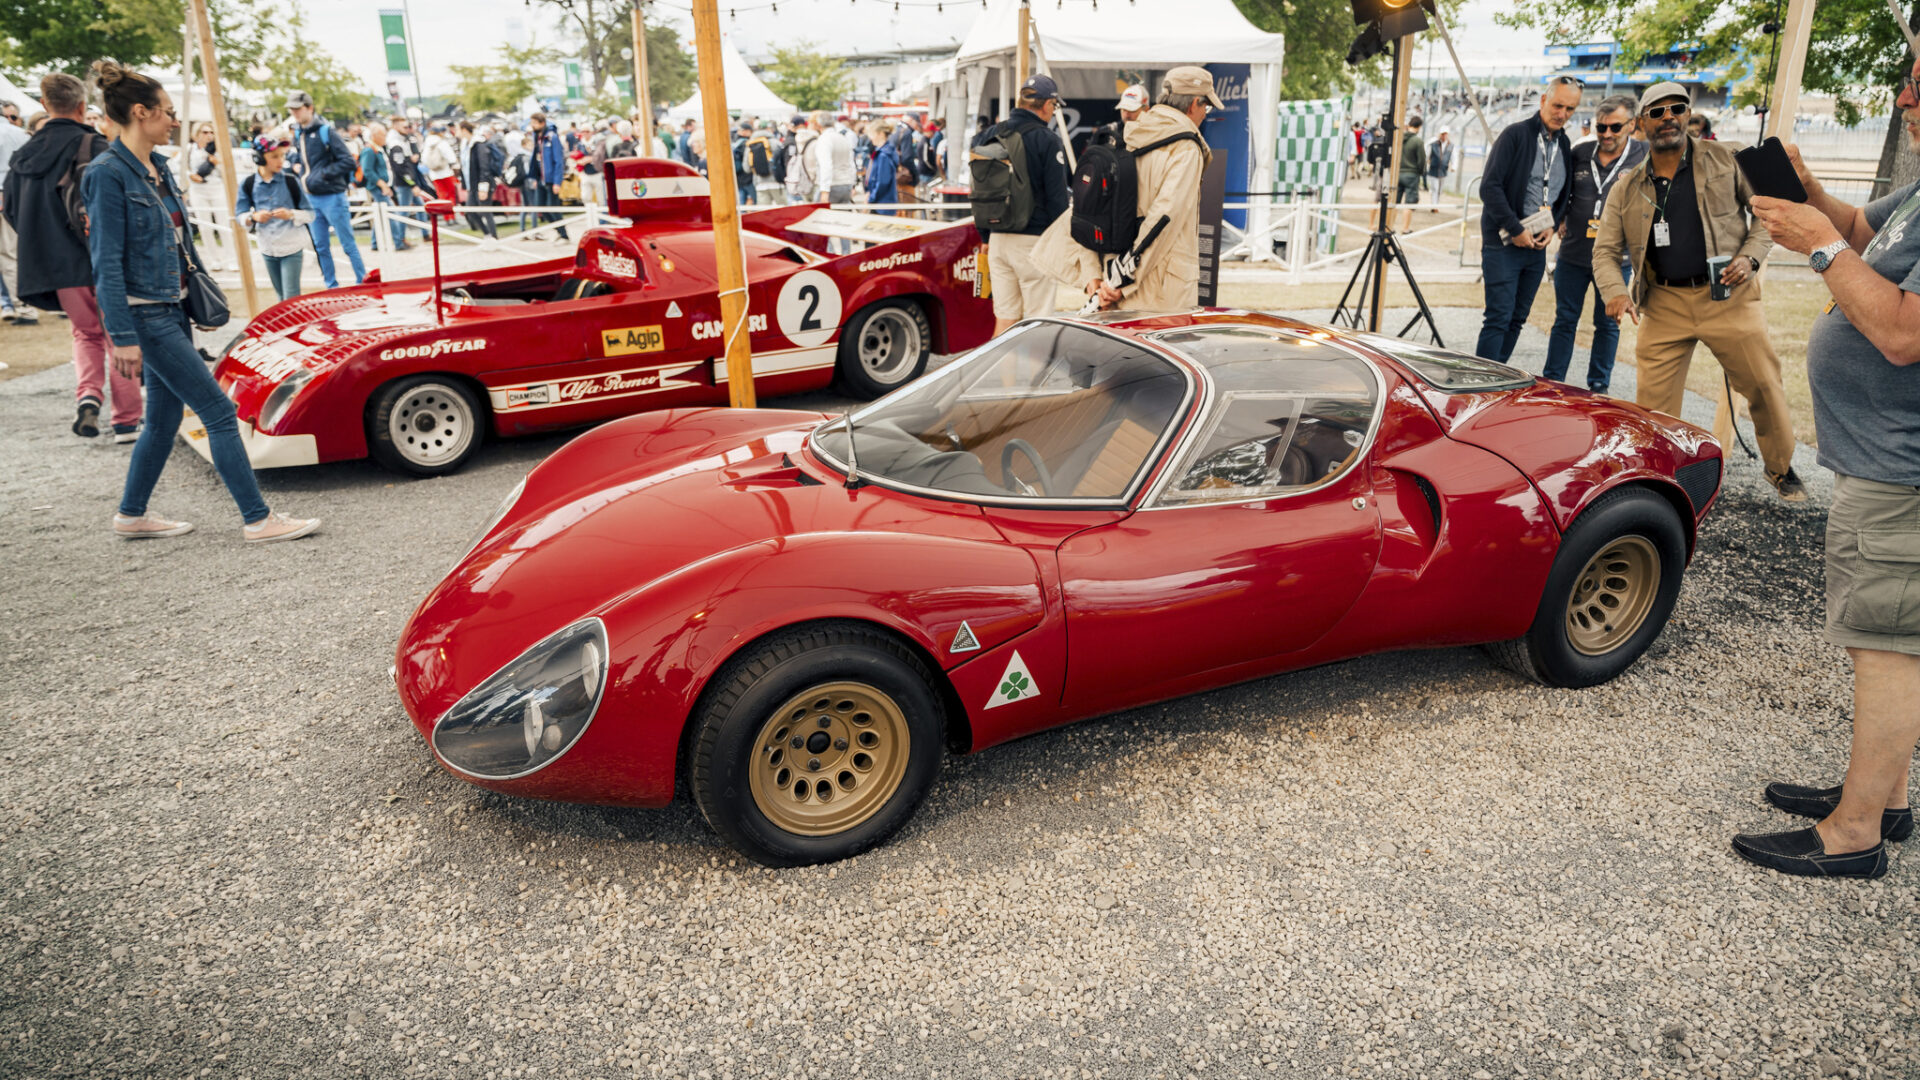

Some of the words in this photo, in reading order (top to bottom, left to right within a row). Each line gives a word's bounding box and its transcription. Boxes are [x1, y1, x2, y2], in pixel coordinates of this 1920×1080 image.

[859, 252, 923, 272] GOODYEAR
[798, 285, 821, 331] 2
[691, 313, 768, 340] CAMRI
[380, 339, 486, 360] GOODYEAR
[626, 329, 660, 349] Agip
[509, 391, 547, 402] CHAMPION
[561, 380, 602, 400] Alfa
[603, 374, 659, 391] Romeo
